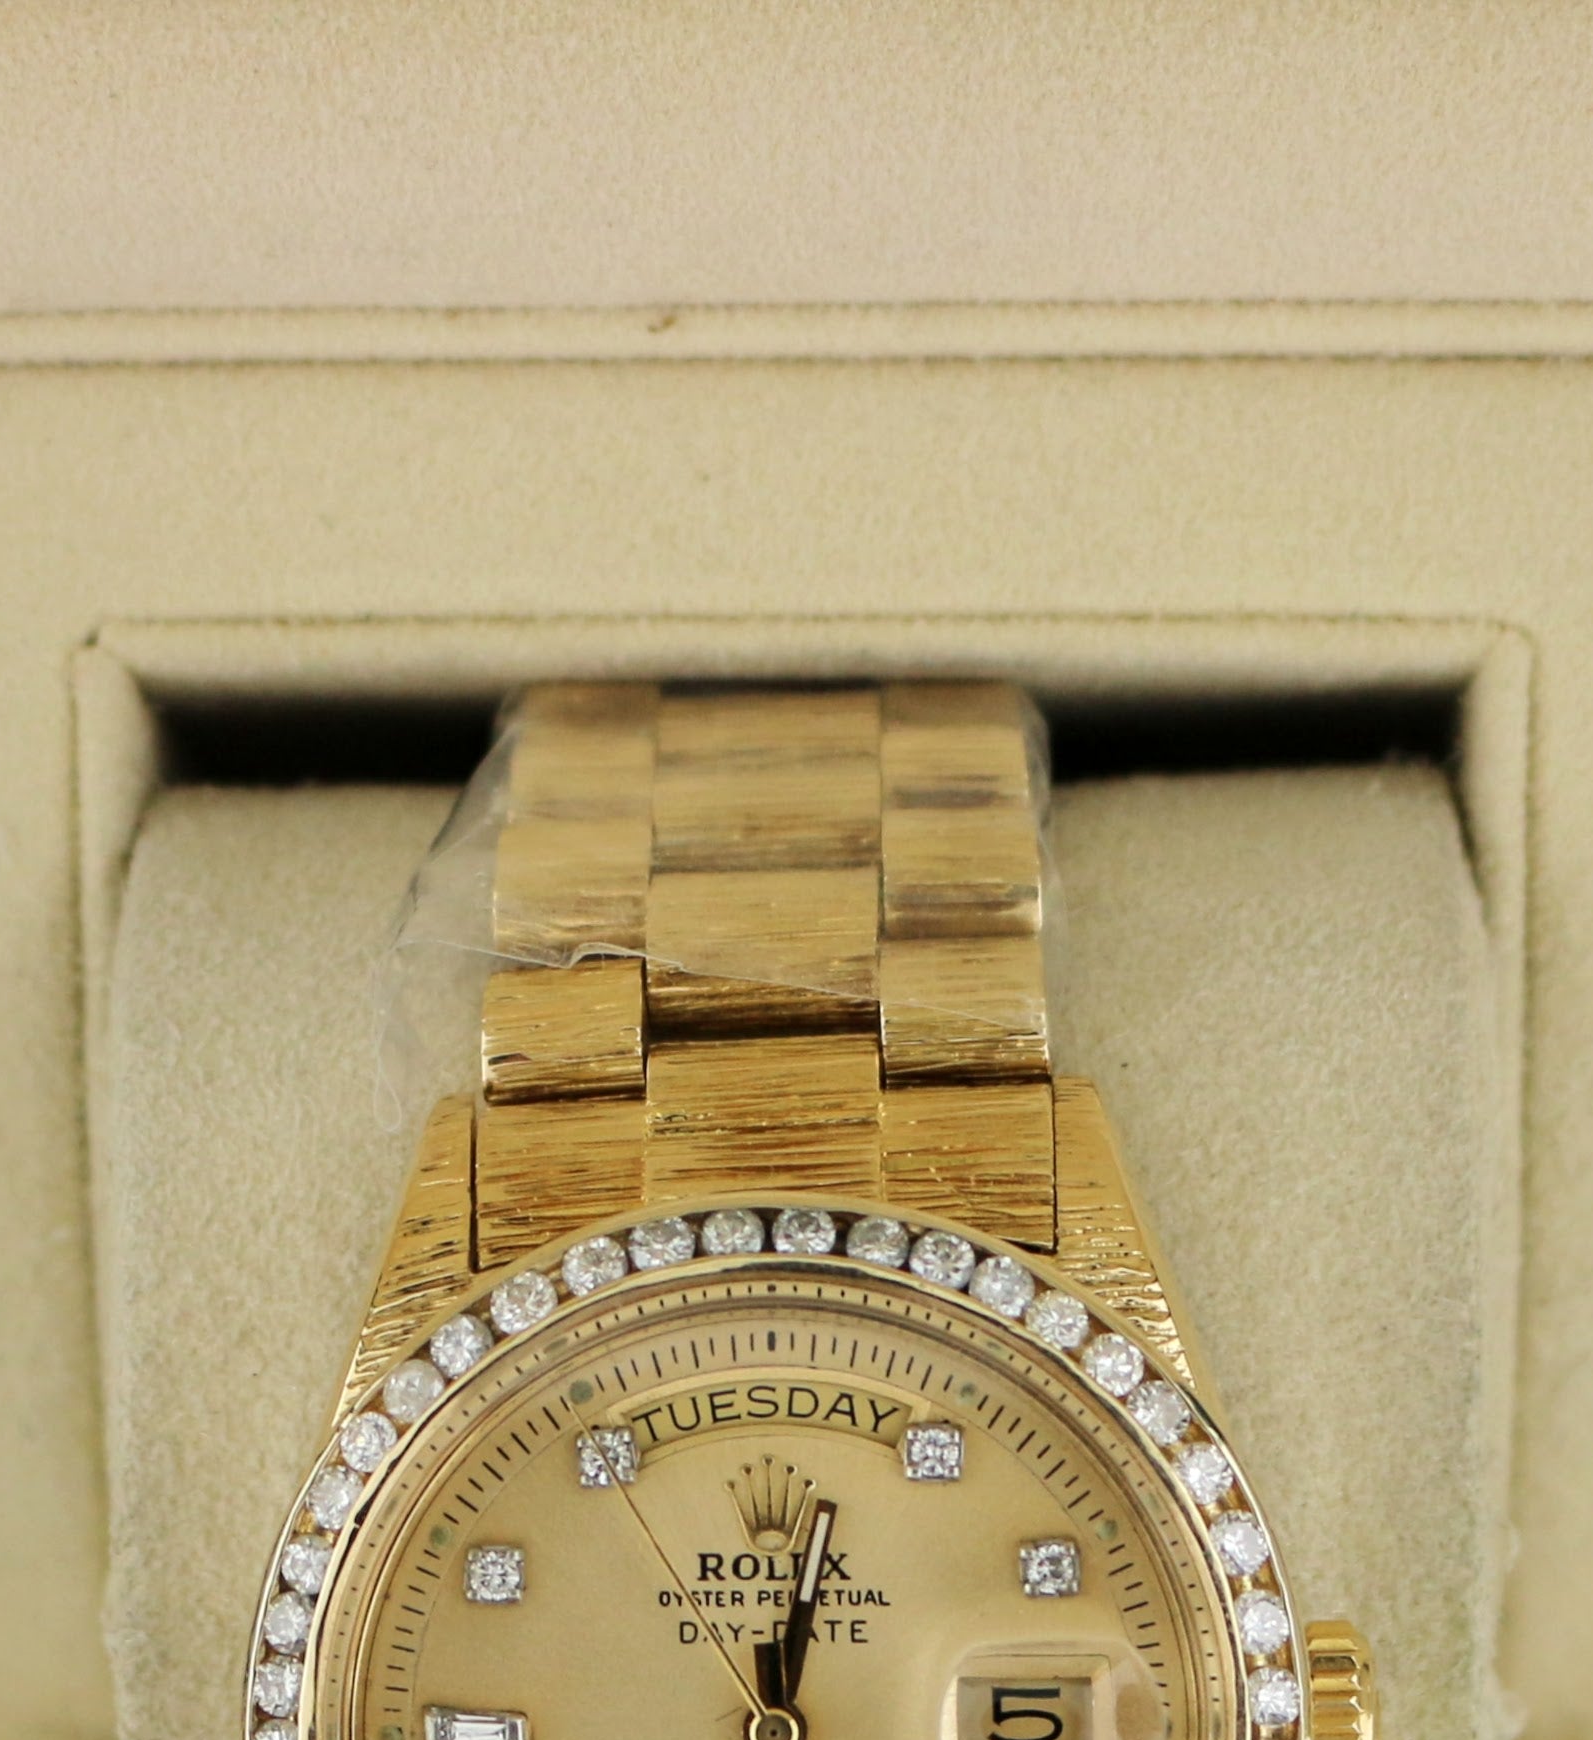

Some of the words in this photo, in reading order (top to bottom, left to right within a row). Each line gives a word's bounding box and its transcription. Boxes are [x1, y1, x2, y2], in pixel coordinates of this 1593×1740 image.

[632, 1385, 901, 1443] TUESDAY
[659, 1589, 745, 1608] OYSTER
[757, 1588, 891, 1607] PEETUAL
